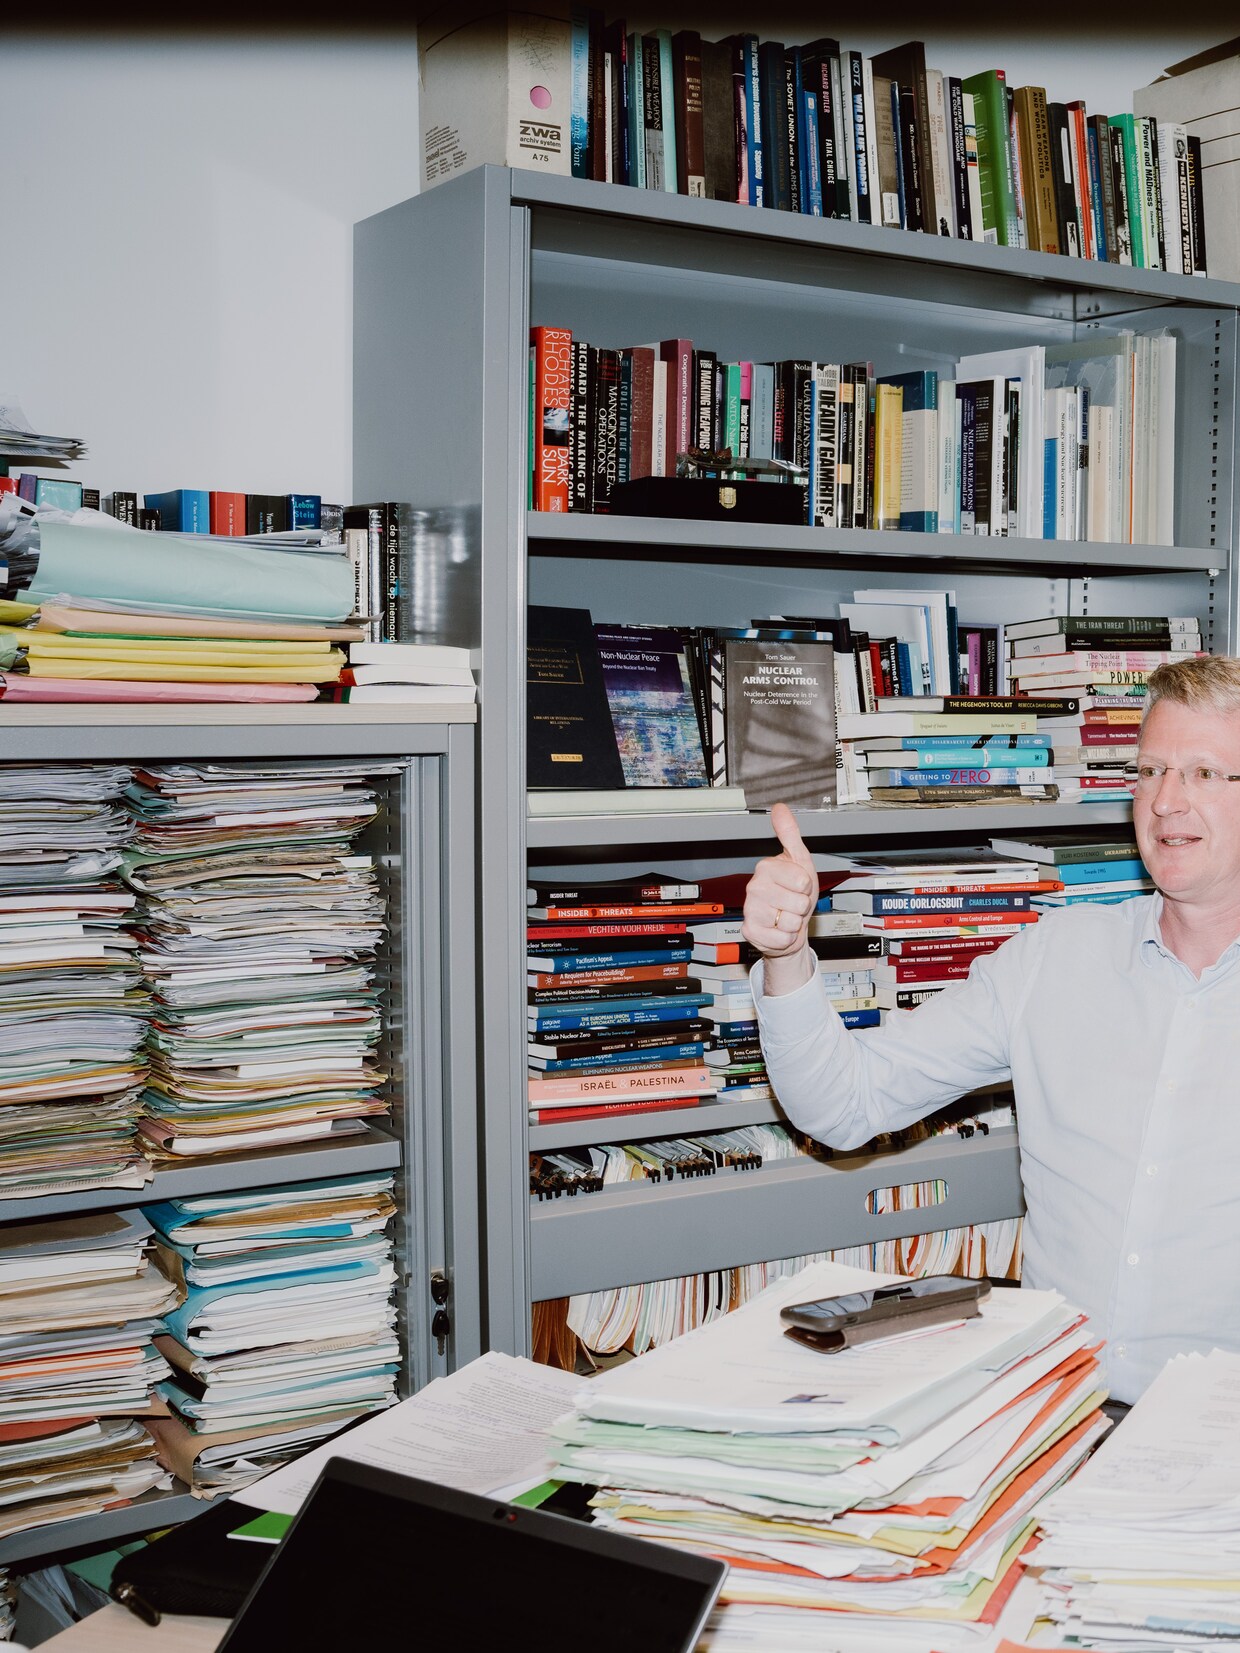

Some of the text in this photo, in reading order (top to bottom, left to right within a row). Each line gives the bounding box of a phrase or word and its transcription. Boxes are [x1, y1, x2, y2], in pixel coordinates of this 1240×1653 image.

[821, 63, 830, 113] RICHARD BUTLER
[852, 60, 860, 87] KOTZ
[652, 92, 660, 129] WEAPONS
[786, 83, 794, 112] SOVIET
[853, 93, 864, 119] WILD
[520, 126, 561, 140] zwa
[520, 136, 561, 148] archiv system
[787, 114, 795, 142] UNION
[854, 122, 866, 150] BLUE
[1034, 111, 1042, 139] WORLD
[1038, 92, 1050, 172] NUCLEAR WEAPONS
[1142, 124, 1150, 149] Power
[825, 139, 835, 184] FATAL CHOICE
[1036, 142, 1044, 179] POLITICS
[1145, 169, 1154, 207] MADness
[1180, 175, 1190, 231] KENNEDY
[1182, 235, 1192, 273] TAPES
[545, 330, 558, 406] RHODES
[558, 332, 570, 409] RICHARD
[606, 386, 618, 445] MANAGING
[680, 354, 689, 452] Cooperative Denuclearization
[699, 370, 712, 449] MAKING WEAPONS
[803, 380, 811, 447] GUARDIANS
[577, 343, 587, 498] RICHARD THE MAKING OF
[597, 408, 606, 474] OPERATIONS
[819, 390, 836, 517] DEADLY GAMBITS
[542, 449, 556, 483] SUN
[557, 448, 568, 486] DARK
[294, 501, 314, 509] Lebow
[387, 525, 398, 642] de tijd wacht op niemand
[600, 651, 660, 662] Non-Nuclear Peace
[758, 667, 803, 675] NUCLEAR
[889, 643, 899, 681] Unarmed
[1085, 660, 1106, 669] Tipping
[742, 676, 819, 685] ARMS CONTROL
[1110, 672, 1143, 684] POWER
[950, 770, 991, 784] ZERO
[558, 907, 633, 917] INSIDER THREATS
[882, 898, 908, 910] KOUDE
[910, 897, 964, 909] OORLOGSBUIT
[968, 898, 991, 906] CHARLES
[588, 923, 666, 934] VECHTEN VOOR VREDE
[580, 1079, 617, 1091] ISRAËL
[630, 1076, 685, 1088] PALESTINA
